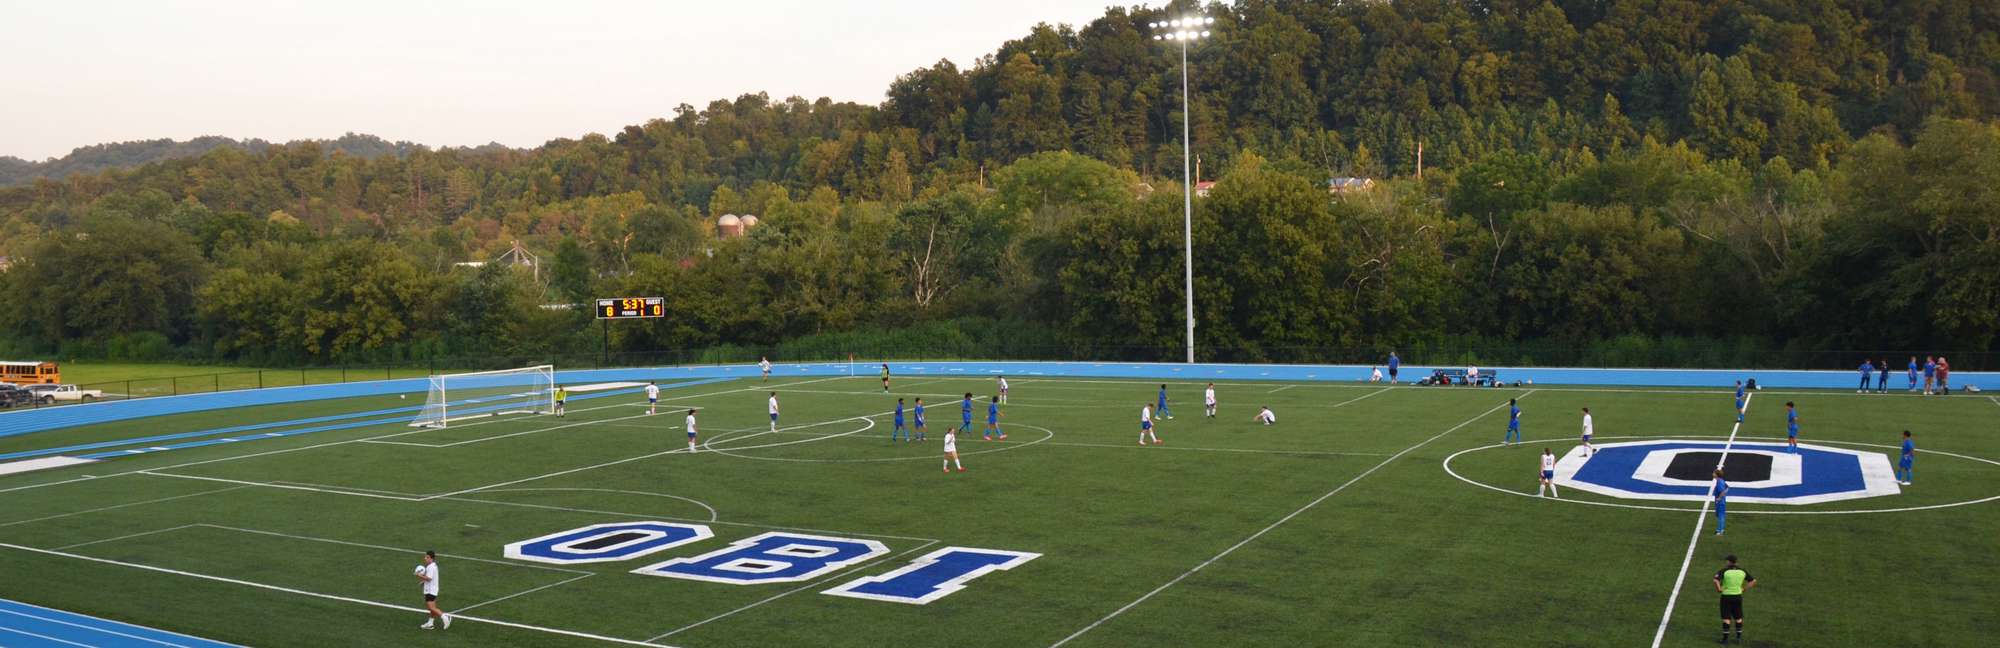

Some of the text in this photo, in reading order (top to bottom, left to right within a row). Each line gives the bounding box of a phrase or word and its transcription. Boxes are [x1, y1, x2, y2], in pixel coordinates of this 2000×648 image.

[622, 299, 645, 310] 5:37
[653, 305, 661, 315] 0
[606, 306, 614, 317] 8
[504, 520, 1044, 605] OBI
